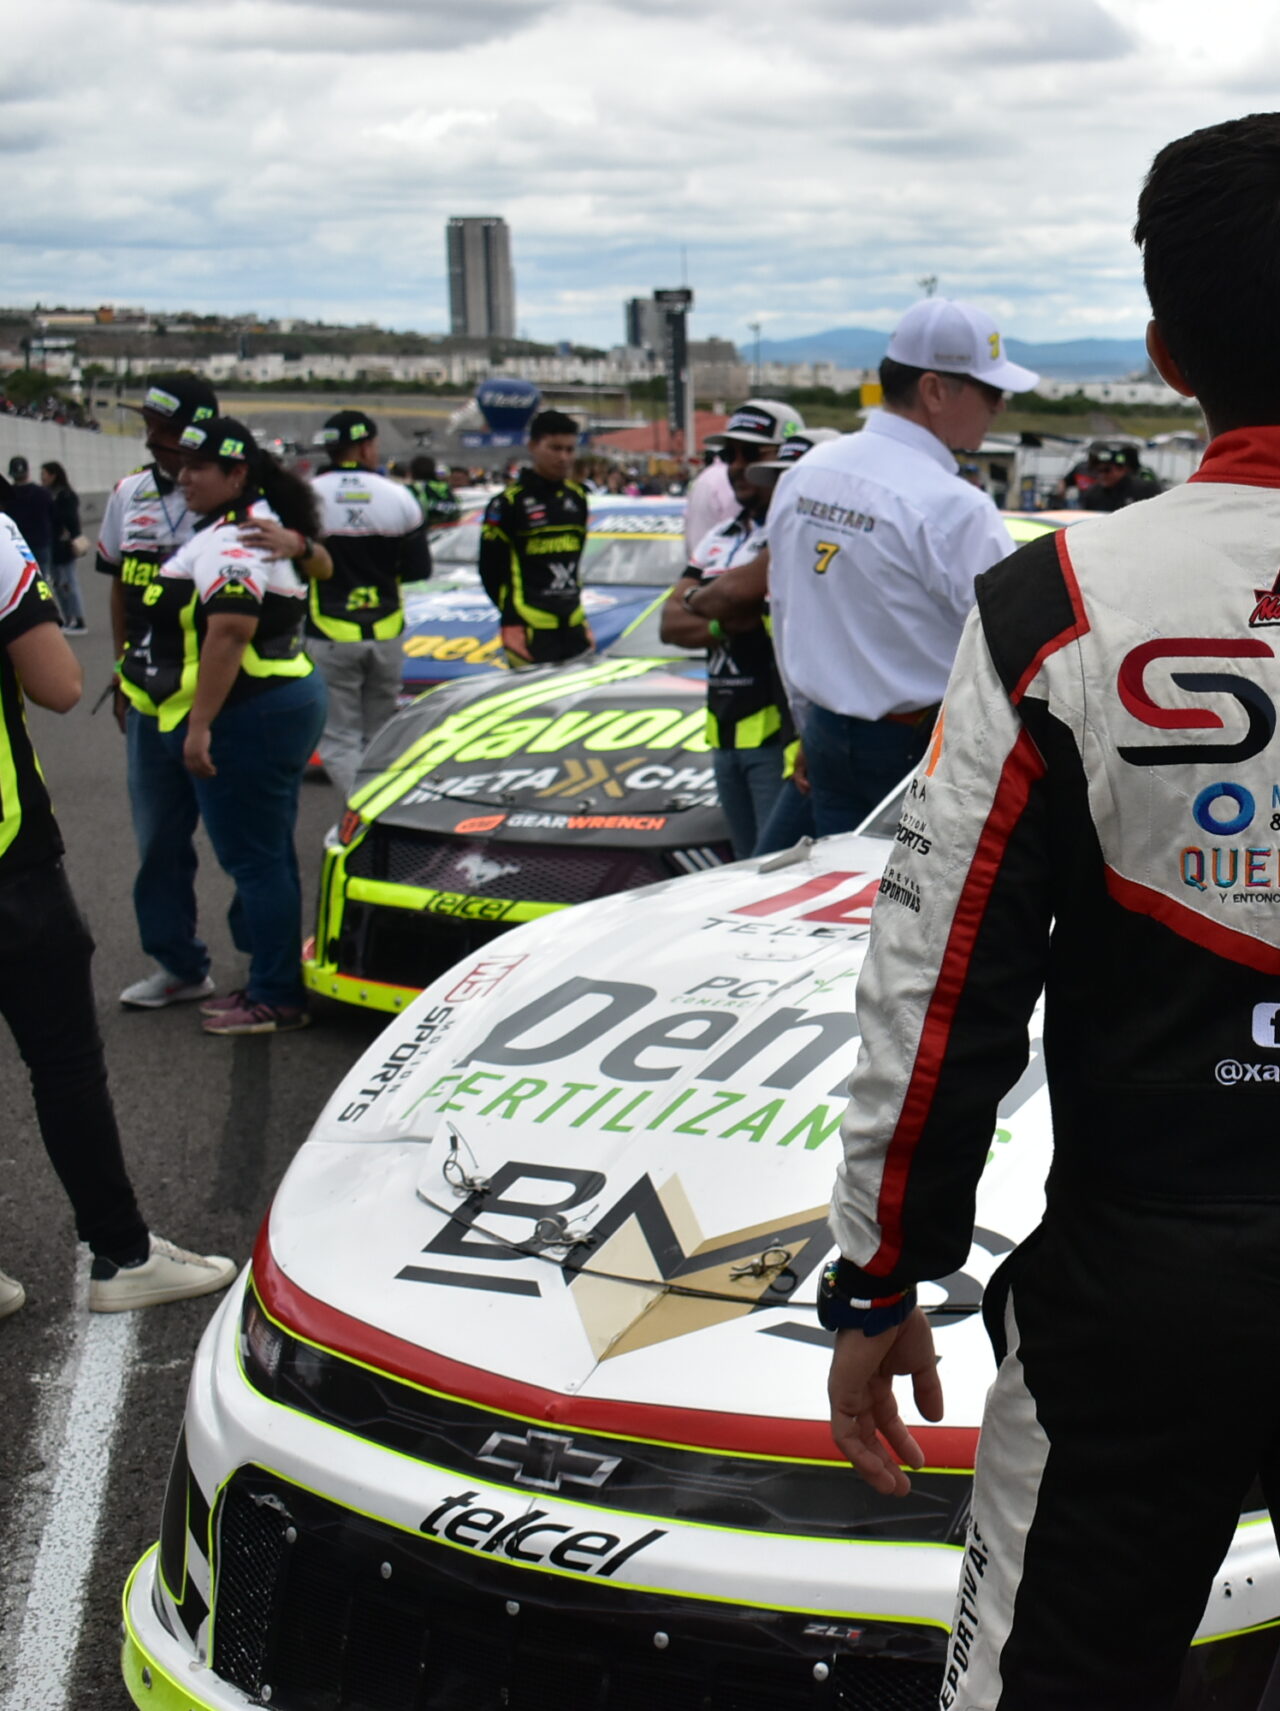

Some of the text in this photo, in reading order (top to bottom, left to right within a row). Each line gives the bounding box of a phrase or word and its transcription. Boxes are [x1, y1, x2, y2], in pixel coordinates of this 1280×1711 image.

[814, 541, 841, 574] 7
[506, 813, 667, 831] GEARWRENCH
[424, 891, 516, 920] telcel
[1218, 893, 1228, 904] Y
[337, 1005, 454, 1122] SPORTS
[400, 1070, 846, 1152] FERTILIZAN
[419, 1490, 669, 1578] telcel
